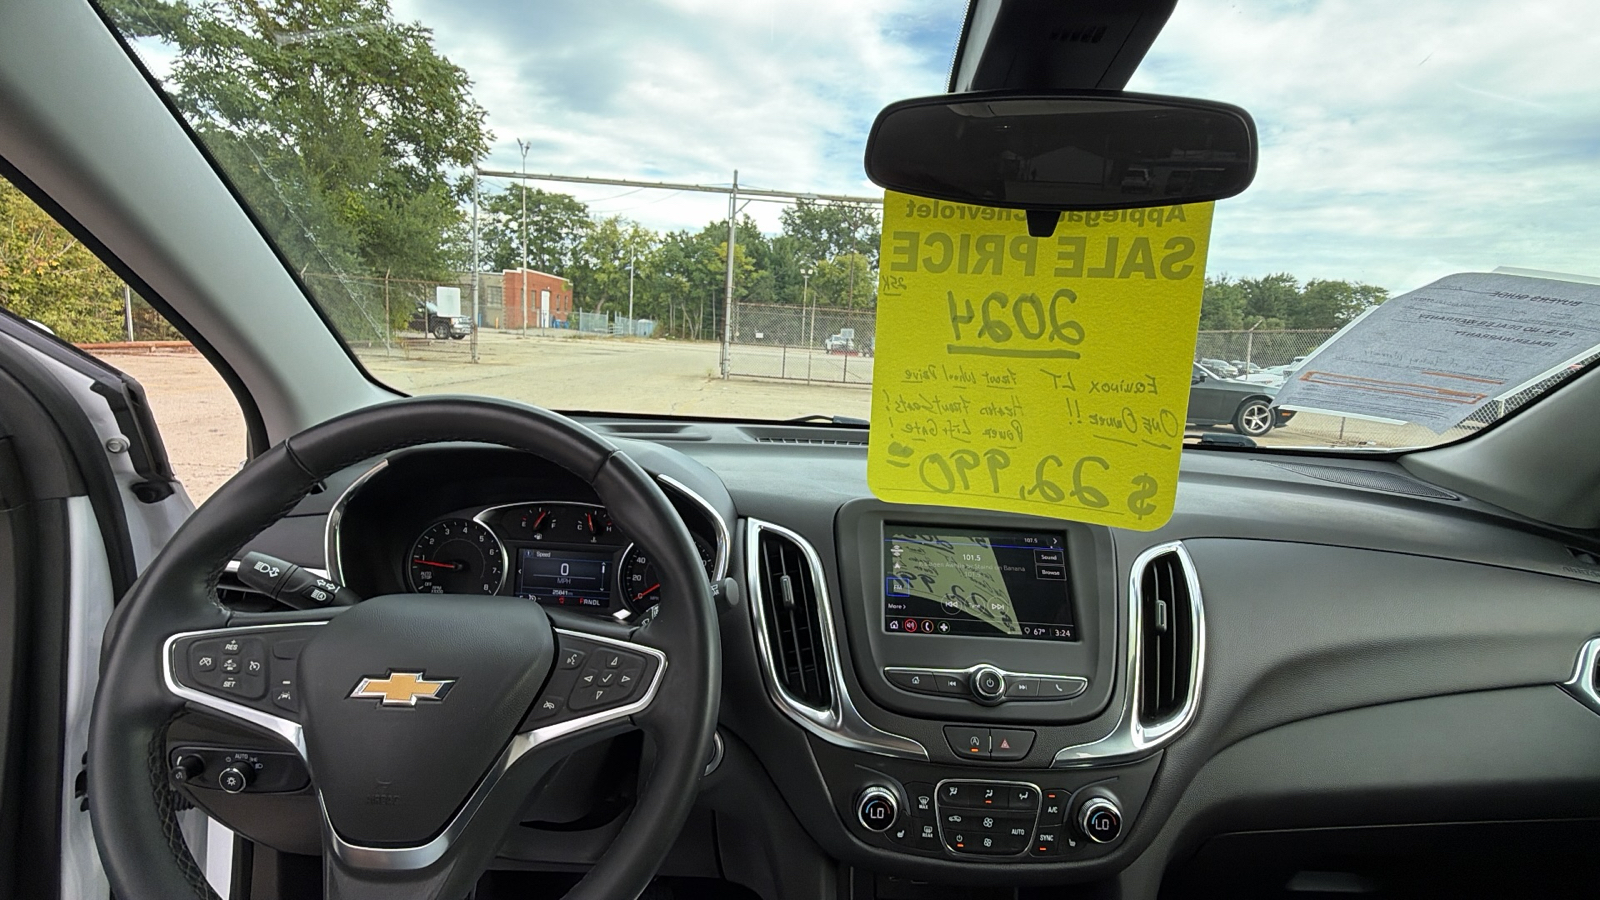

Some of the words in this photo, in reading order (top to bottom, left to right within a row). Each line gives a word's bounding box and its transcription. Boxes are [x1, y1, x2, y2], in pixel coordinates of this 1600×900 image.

[536, 551, 551, 559] Speed
[962, 553, 981, 562] 101.5
[636, 556, 646, 564] 40
[560, 562, 569, 576] 0
[556, 577, 572, 585] MPH
[1054, 629, 1071, 638] 3:24
[1047, 806, 1058, 814] A/C
[1011, 828, 1025, 836] AUTO
[1039, 834, 1054, 842] SYNC
